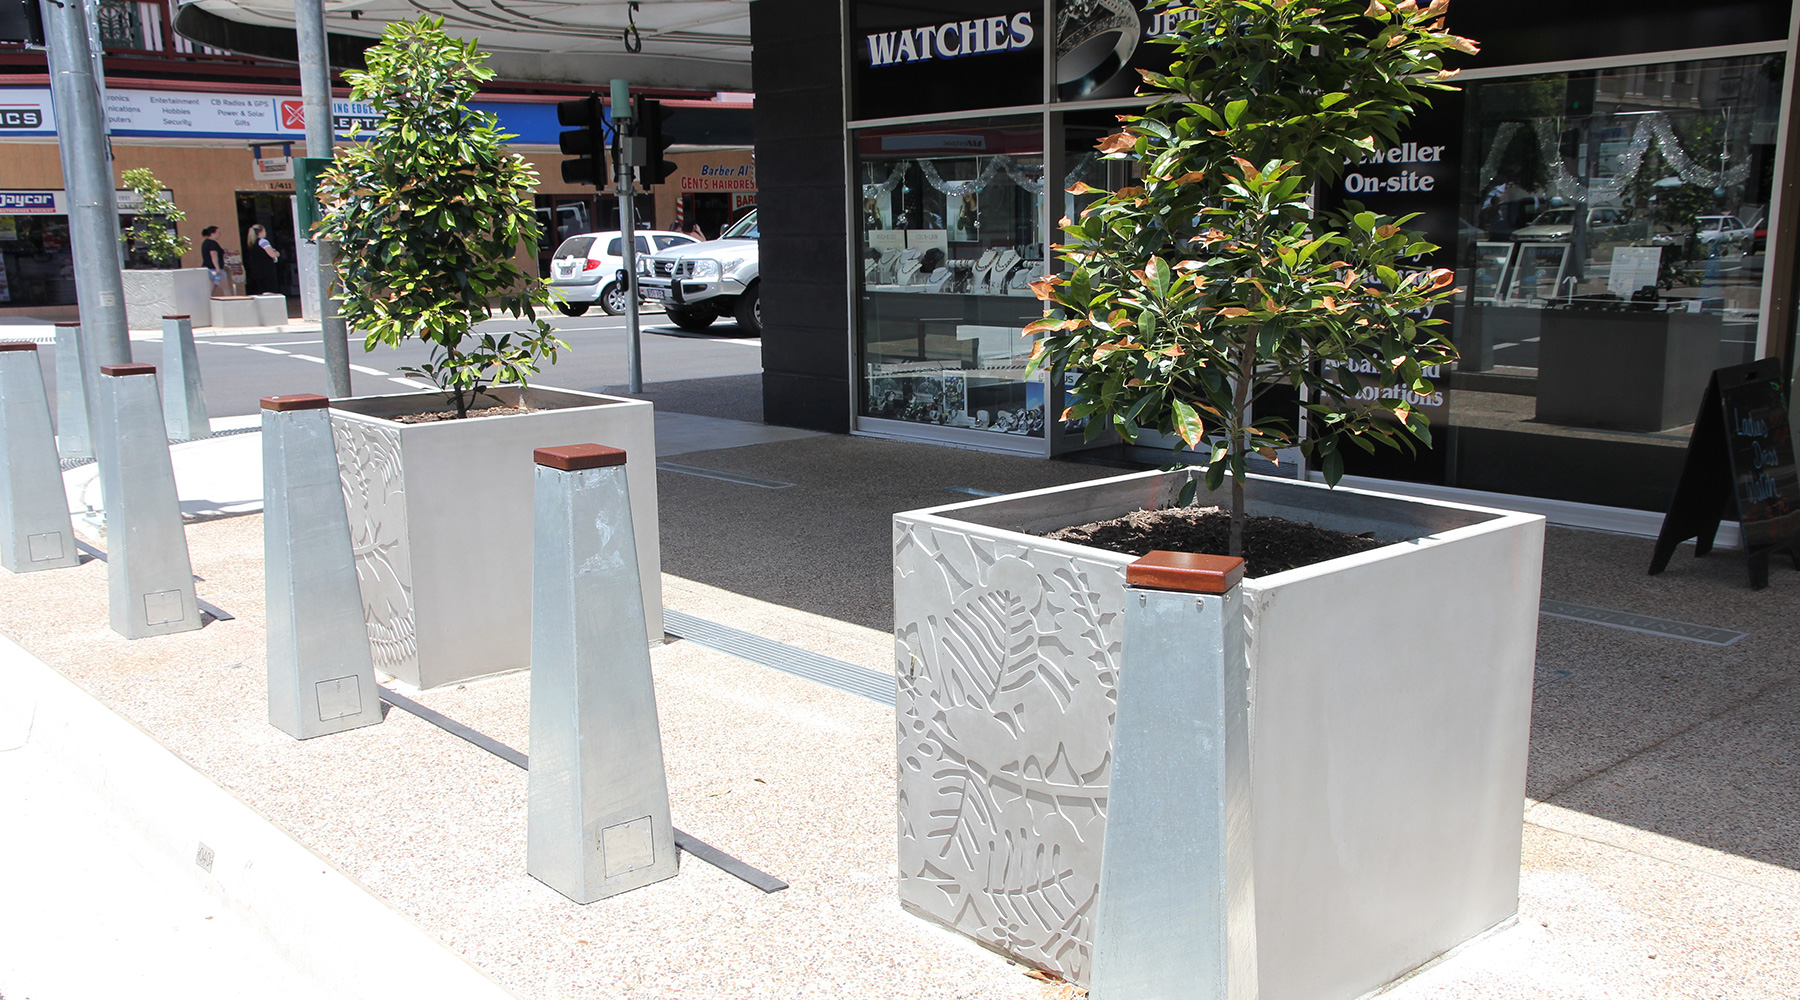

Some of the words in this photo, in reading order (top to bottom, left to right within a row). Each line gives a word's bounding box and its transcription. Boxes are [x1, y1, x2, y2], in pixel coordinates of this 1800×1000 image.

[867, 12, 1034, 67] WATCHES
[149, 96, 199, 105] Entertainment
[210, 98, 221, 106] CB
[222, 99, 246, 107] Radios
[162, 107, 191, 115] Hobbies
[352, 103, 373, 114] EDGE
[162, 118, 192, 126] Security
[234, 119, 251, 127] Gifts
[1343, 142, 1445, 165] weller
[701, 164, 735, 176] Barber
[681, 176, 709, 190] GENTS
[712, 179, 758, 190] HAIRDRES
[1344, 170, 1435, 193] On-site
